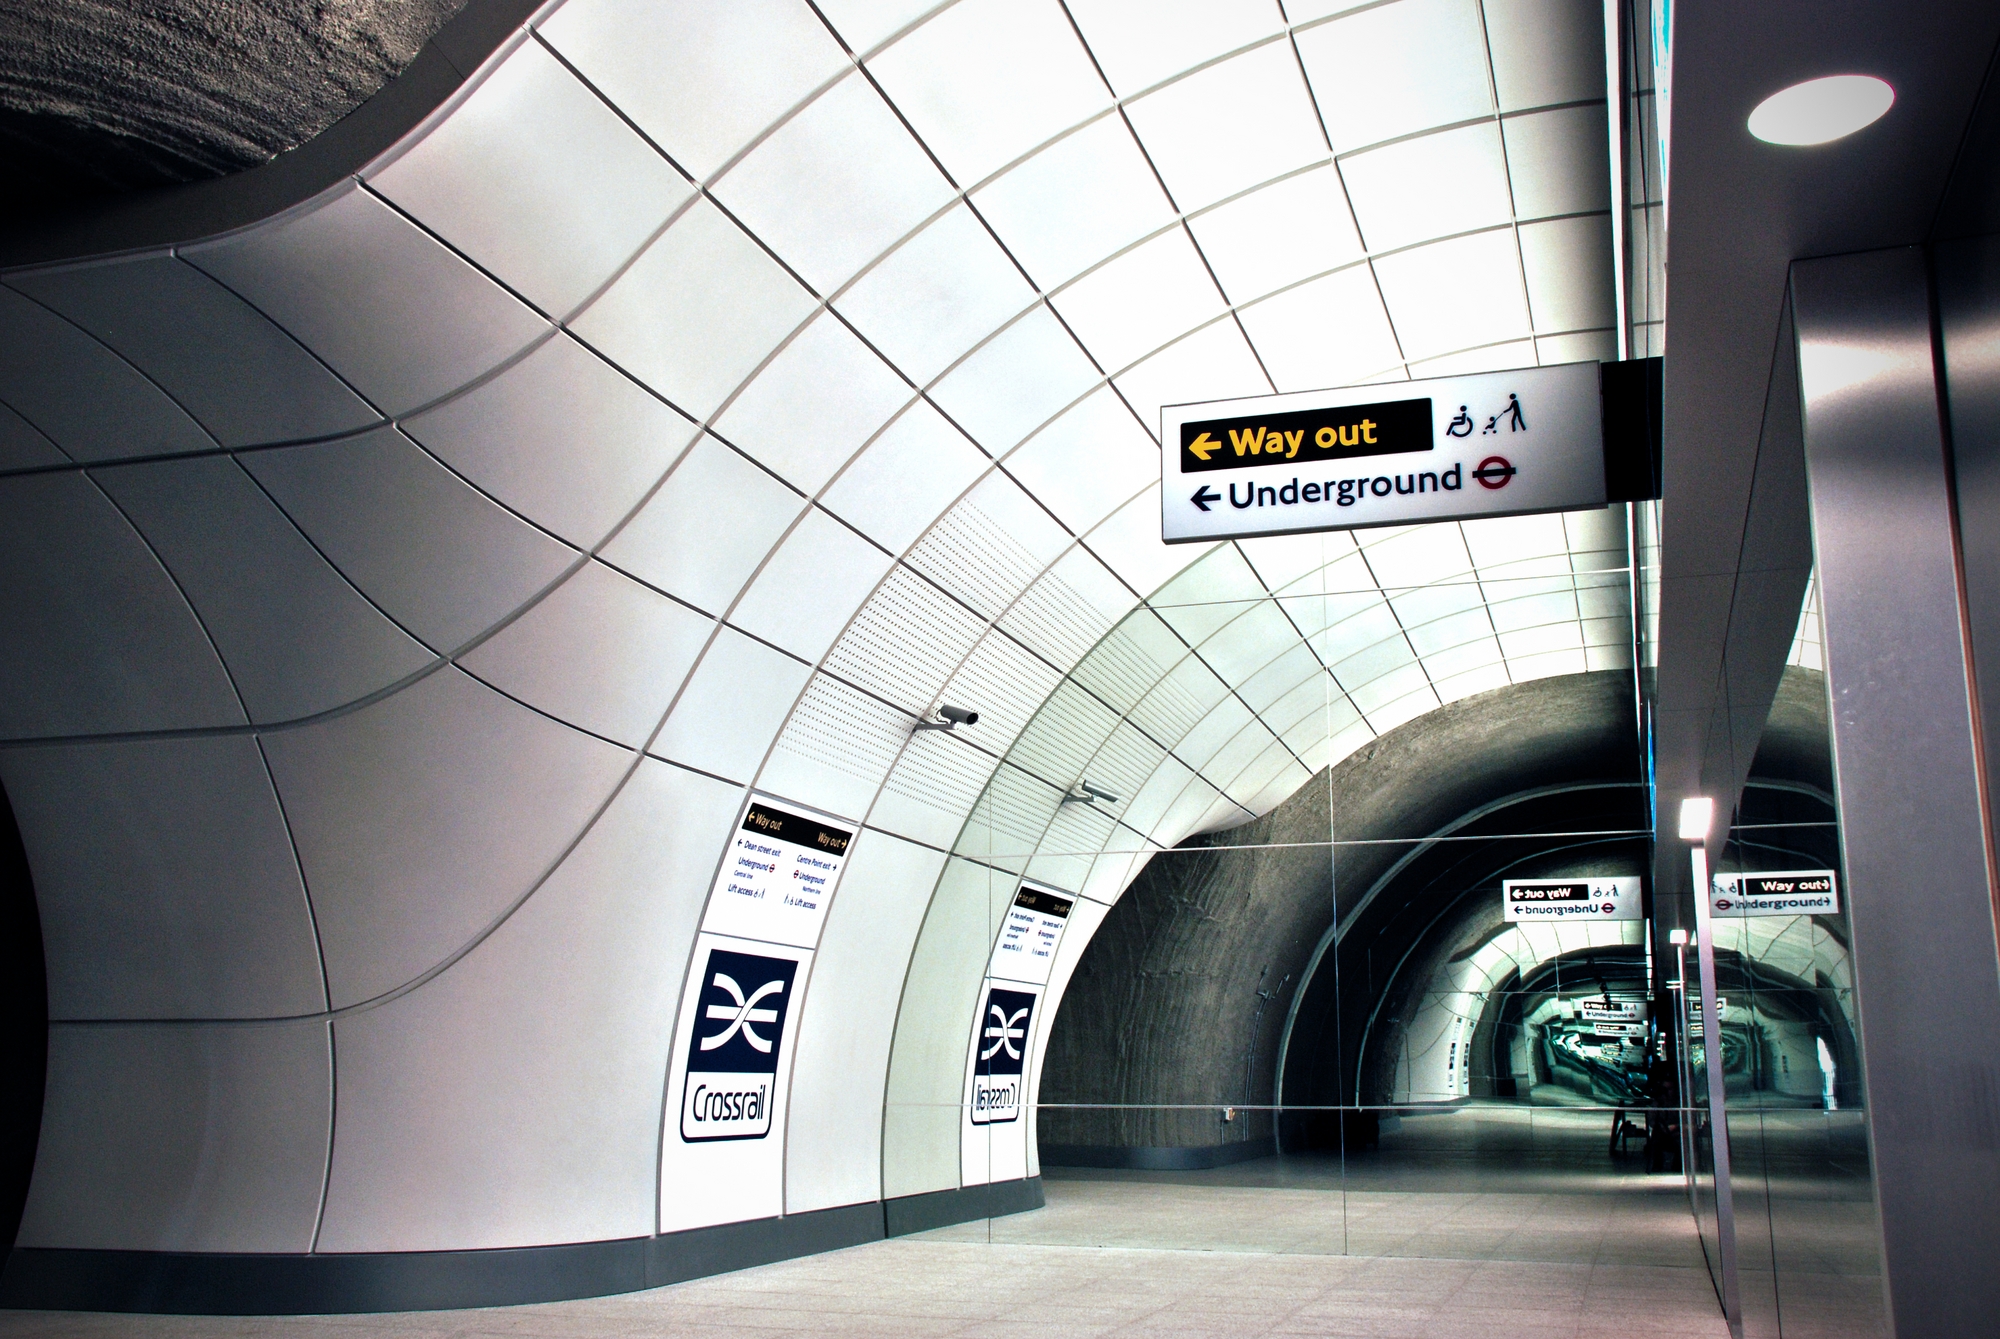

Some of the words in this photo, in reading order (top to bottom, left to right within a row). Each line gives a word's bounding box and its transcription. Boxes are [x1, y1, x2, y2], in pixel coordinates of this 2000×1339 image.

[1229, 427, 1304, 460] Way
[1315, 418, 1378, 449] out
[1229, 463, 1462, 509] Underground
[755, 813, 771, 829] Way
[769, 820, 783, 831] out
[818, 832, 831, 846] Way
[830, 838, 842, 848] out
[744, 840, 758, 851] Dean
[757, 845, 772, 855] street
[771, 849, 782, 857] exit
[738, 857, 769, 871] Underground
[797, 854, 812, 865] Centre
[811, 858, 823, 868] Point
[822, 862, 831, 870] exit
[799, 872, 826, 885] Underground
[728, 883, 738, 893] Lift
[737, 887, 753, 896] access
[1761, 881, 1794, 893] Way
[1798, 881, 1821, 890] out
[795, 898, 803, 906] Lift
[803, 901, 817, 910] access
[693, 1084, 766, 1122] Crossrail
